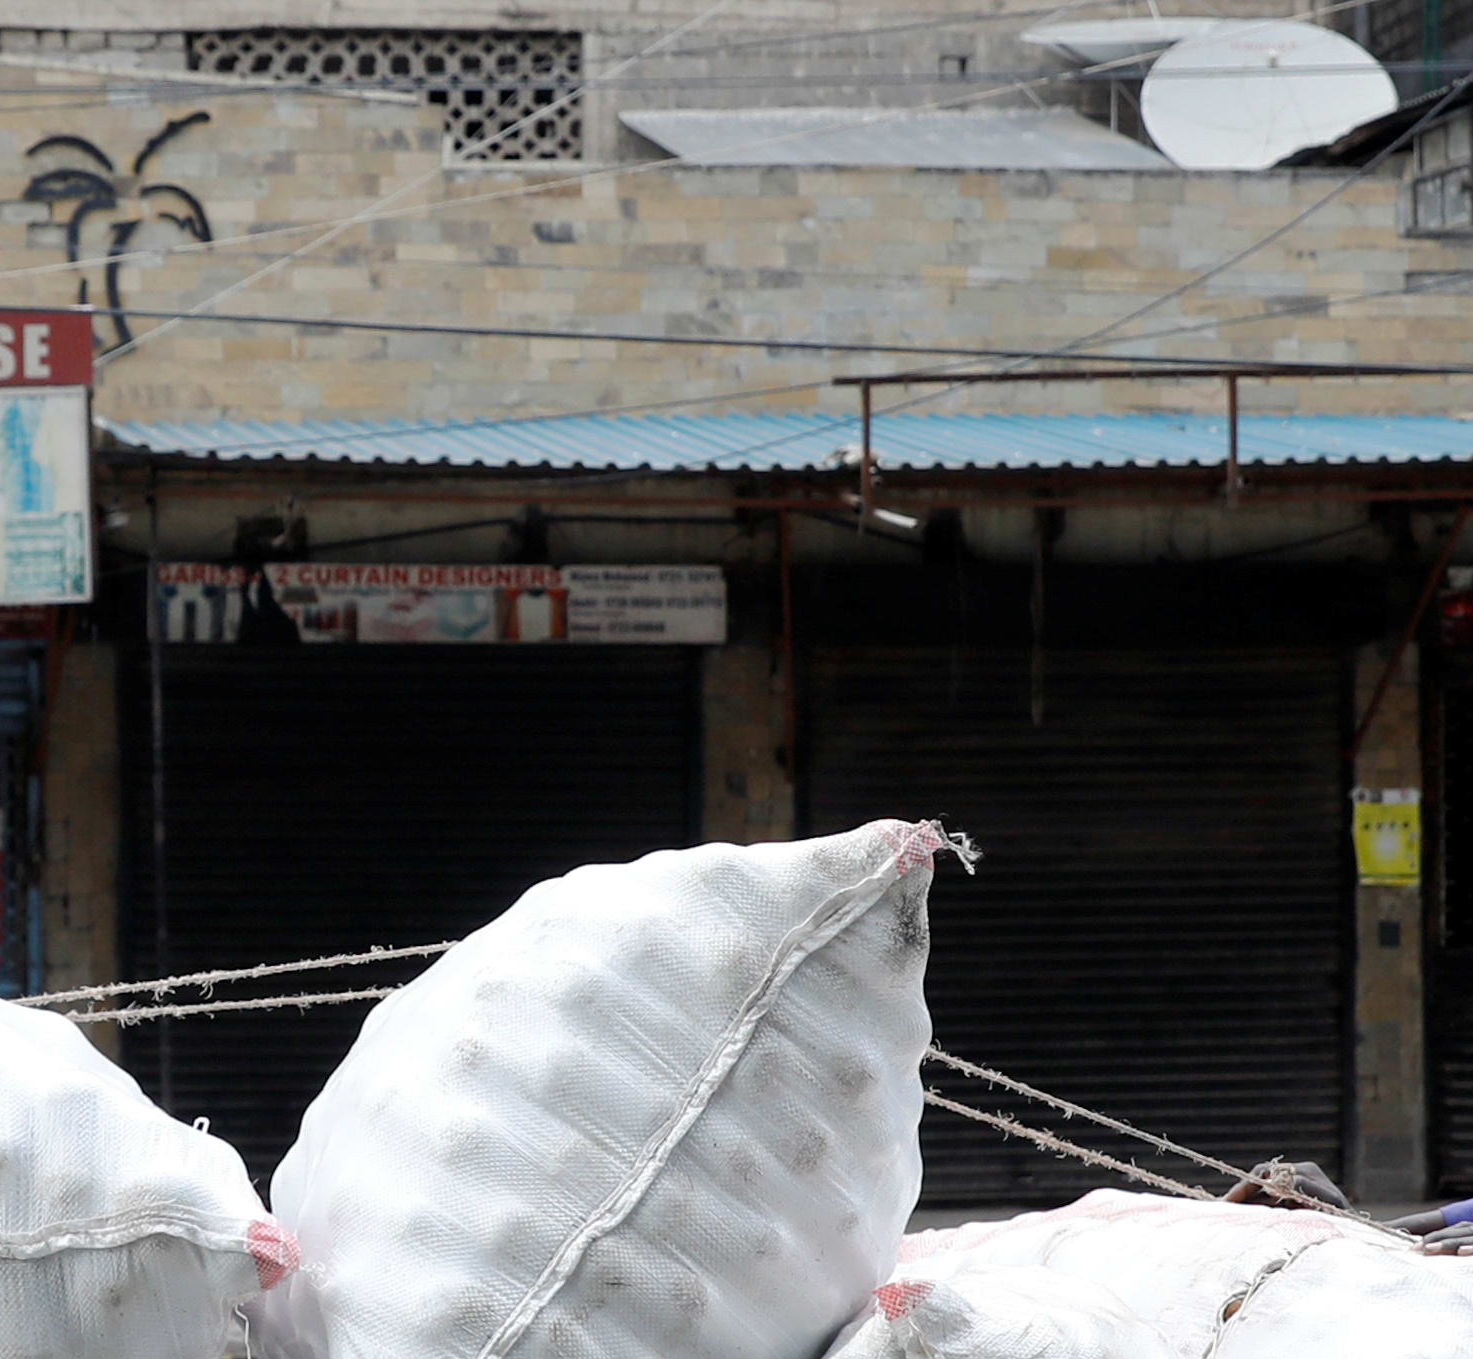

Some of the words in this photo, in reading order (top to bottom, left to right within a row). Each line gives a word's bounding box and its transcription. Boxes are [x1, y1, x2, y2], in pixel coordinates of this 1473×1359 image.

[275, 565, 291, 586] 2
[297, 564, 409, 588] CURTAIN
[418, 566, 563, 589] DESIGNERS
